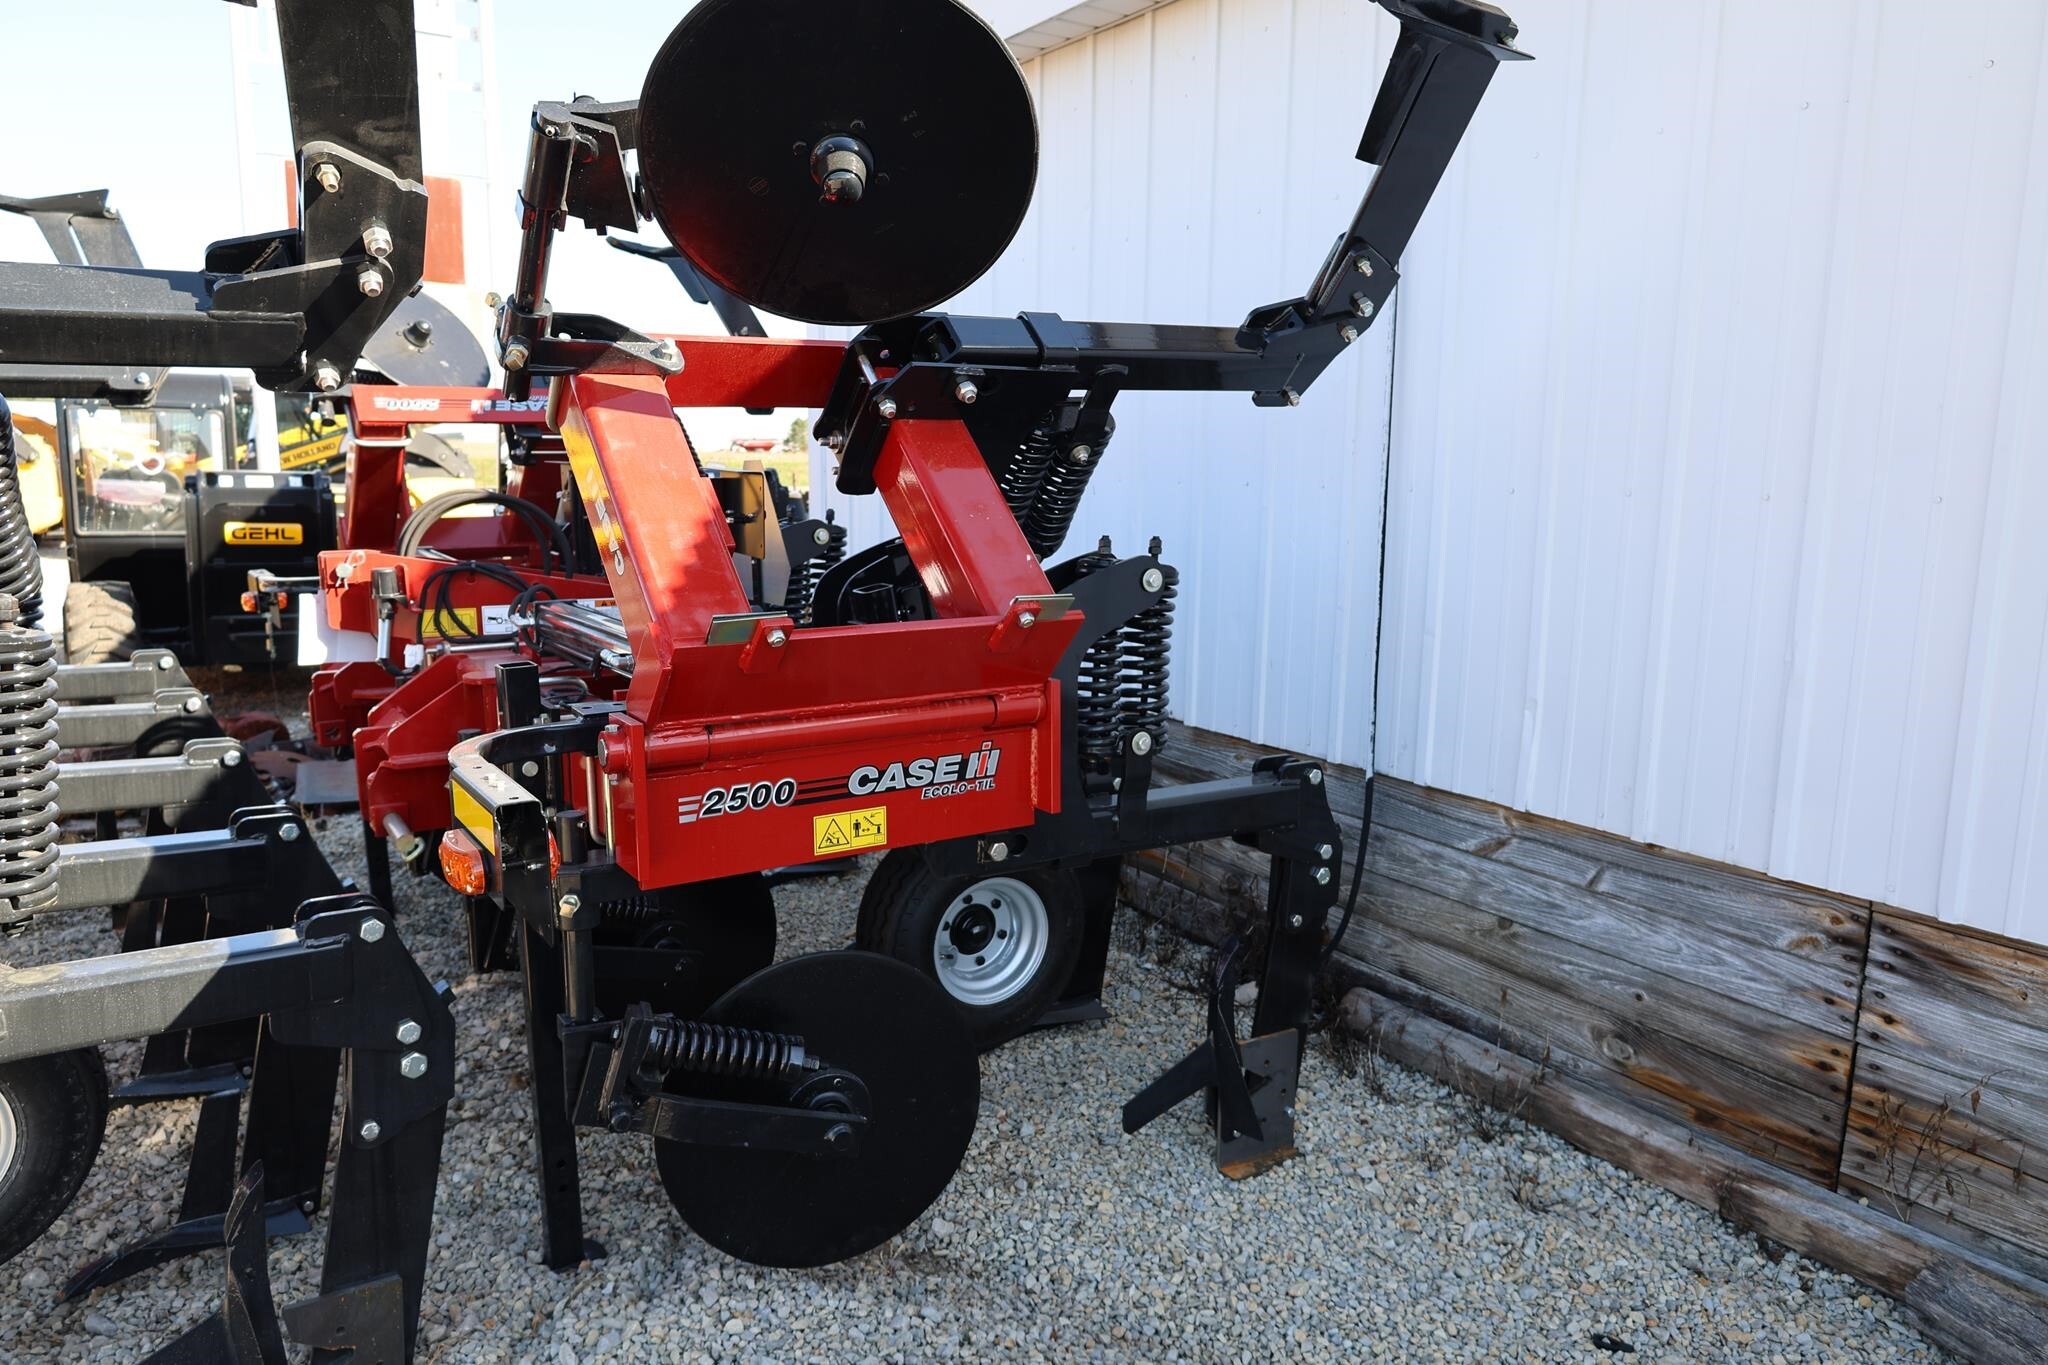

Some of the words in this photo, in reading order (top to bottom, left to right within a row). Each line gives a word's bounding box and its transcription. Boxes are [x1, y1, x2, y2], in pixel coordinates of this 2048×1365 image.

[495, 399, 551, 412] ASE
[231, 527, 296, 540] GEHL
[699, 777, 797, 820] 2500
[847, 753, 963, 796] CASE
[920, 778, 996, 800] ECOLO-TIL
